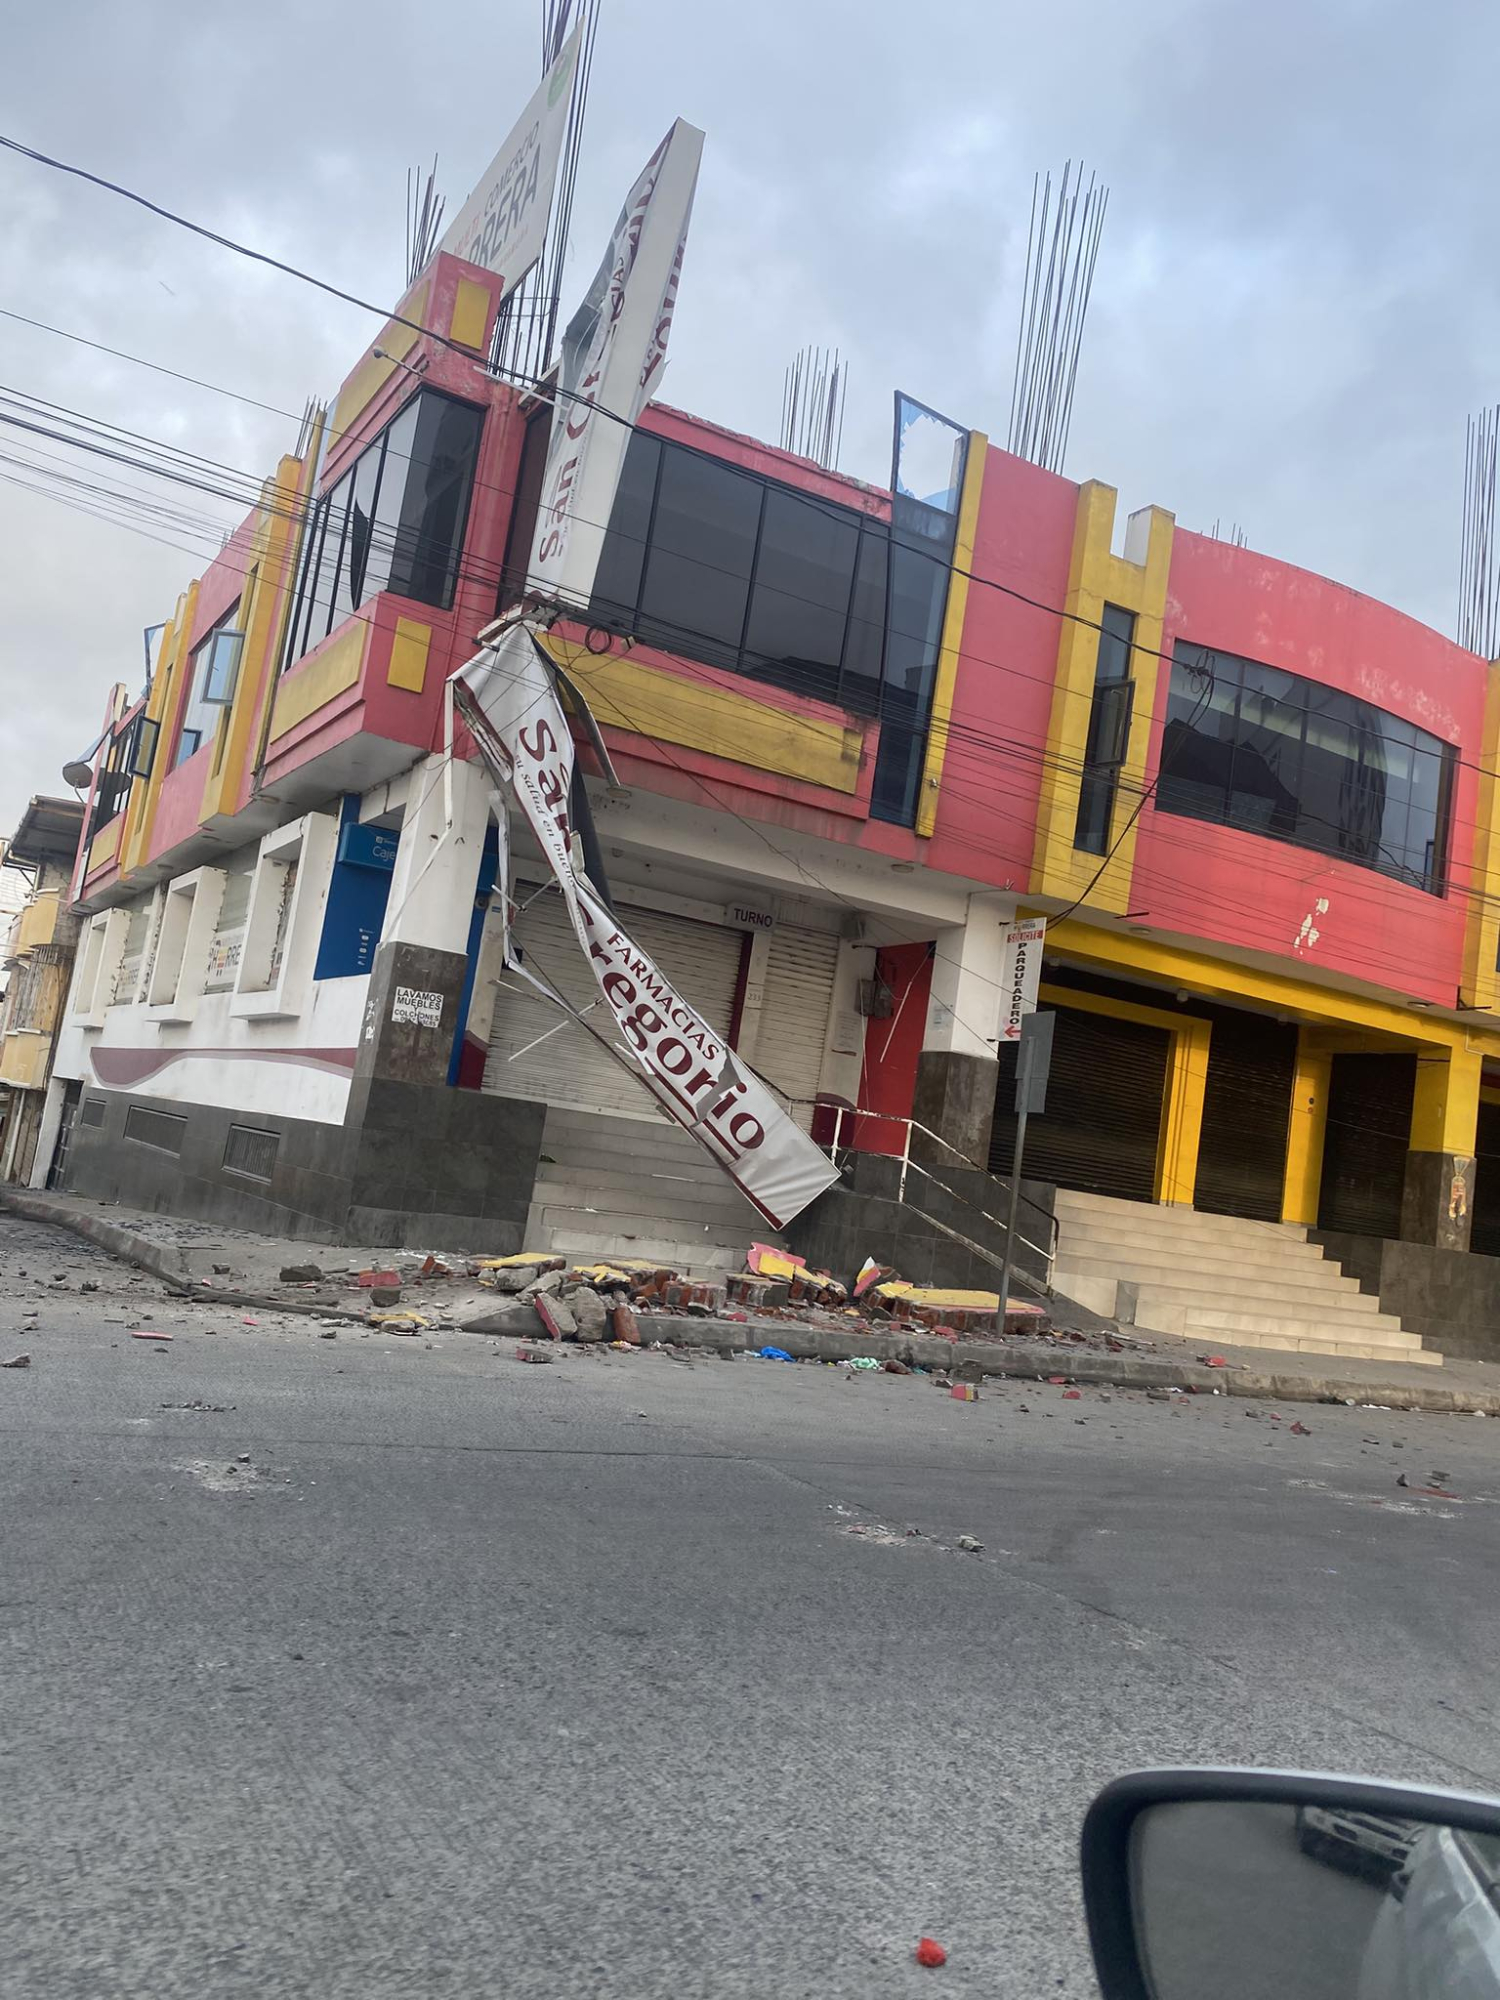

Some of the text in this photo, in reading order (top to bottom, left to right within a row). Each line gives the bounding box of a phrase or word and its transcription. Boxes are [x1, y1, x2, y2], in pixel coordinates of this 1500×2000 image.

[484, 120, 540, 217] COMERCIO
[521, 772, 546, 816] salud
[734, 907, 773, 928] TURNO
[397, 988, 442, 1003] LAVAMOS
[606, 931, 720, 1061] FARMACIAS
[1009, 942, 1028, 1025] PARQUEADERO
[394, 1008, 440, 1022] COLCHONES
[396, 996, 441, 1011] MUEBLES
